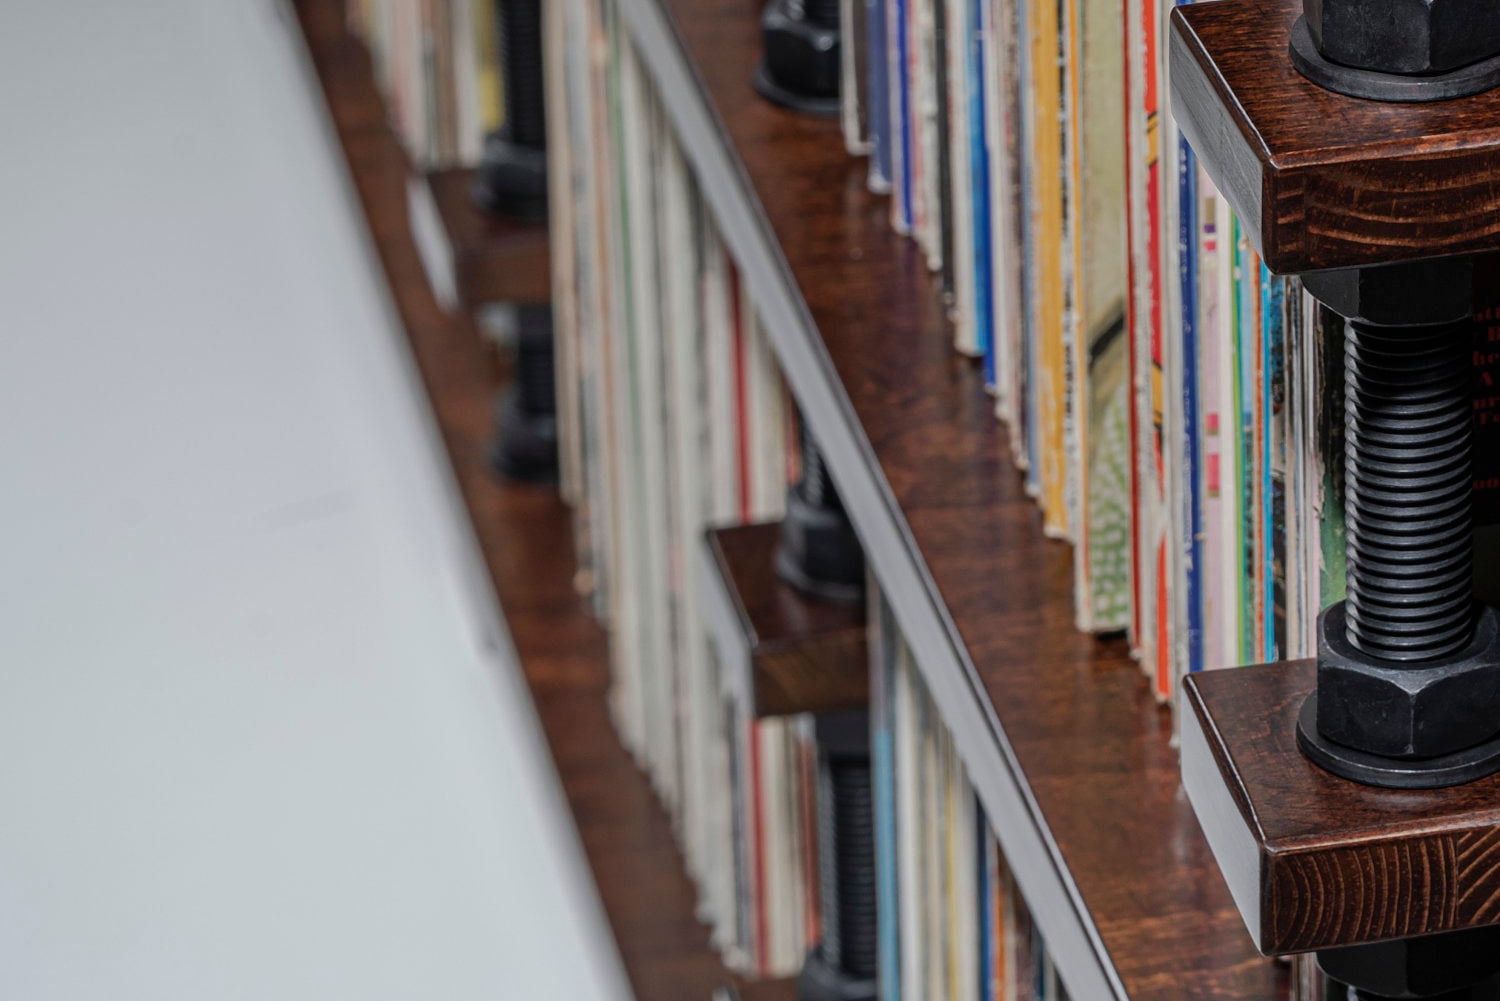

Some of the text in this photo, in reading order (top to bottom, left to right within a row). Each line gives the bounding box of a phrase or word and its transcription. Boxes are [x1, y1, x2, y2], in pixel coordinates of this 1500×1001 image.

[1472, 350, 1500, 367] he
[1478, 370, 1494, 388] A
[1472, 395, 1500, 410] ur
[1472, 476, 1500, 490] oo
